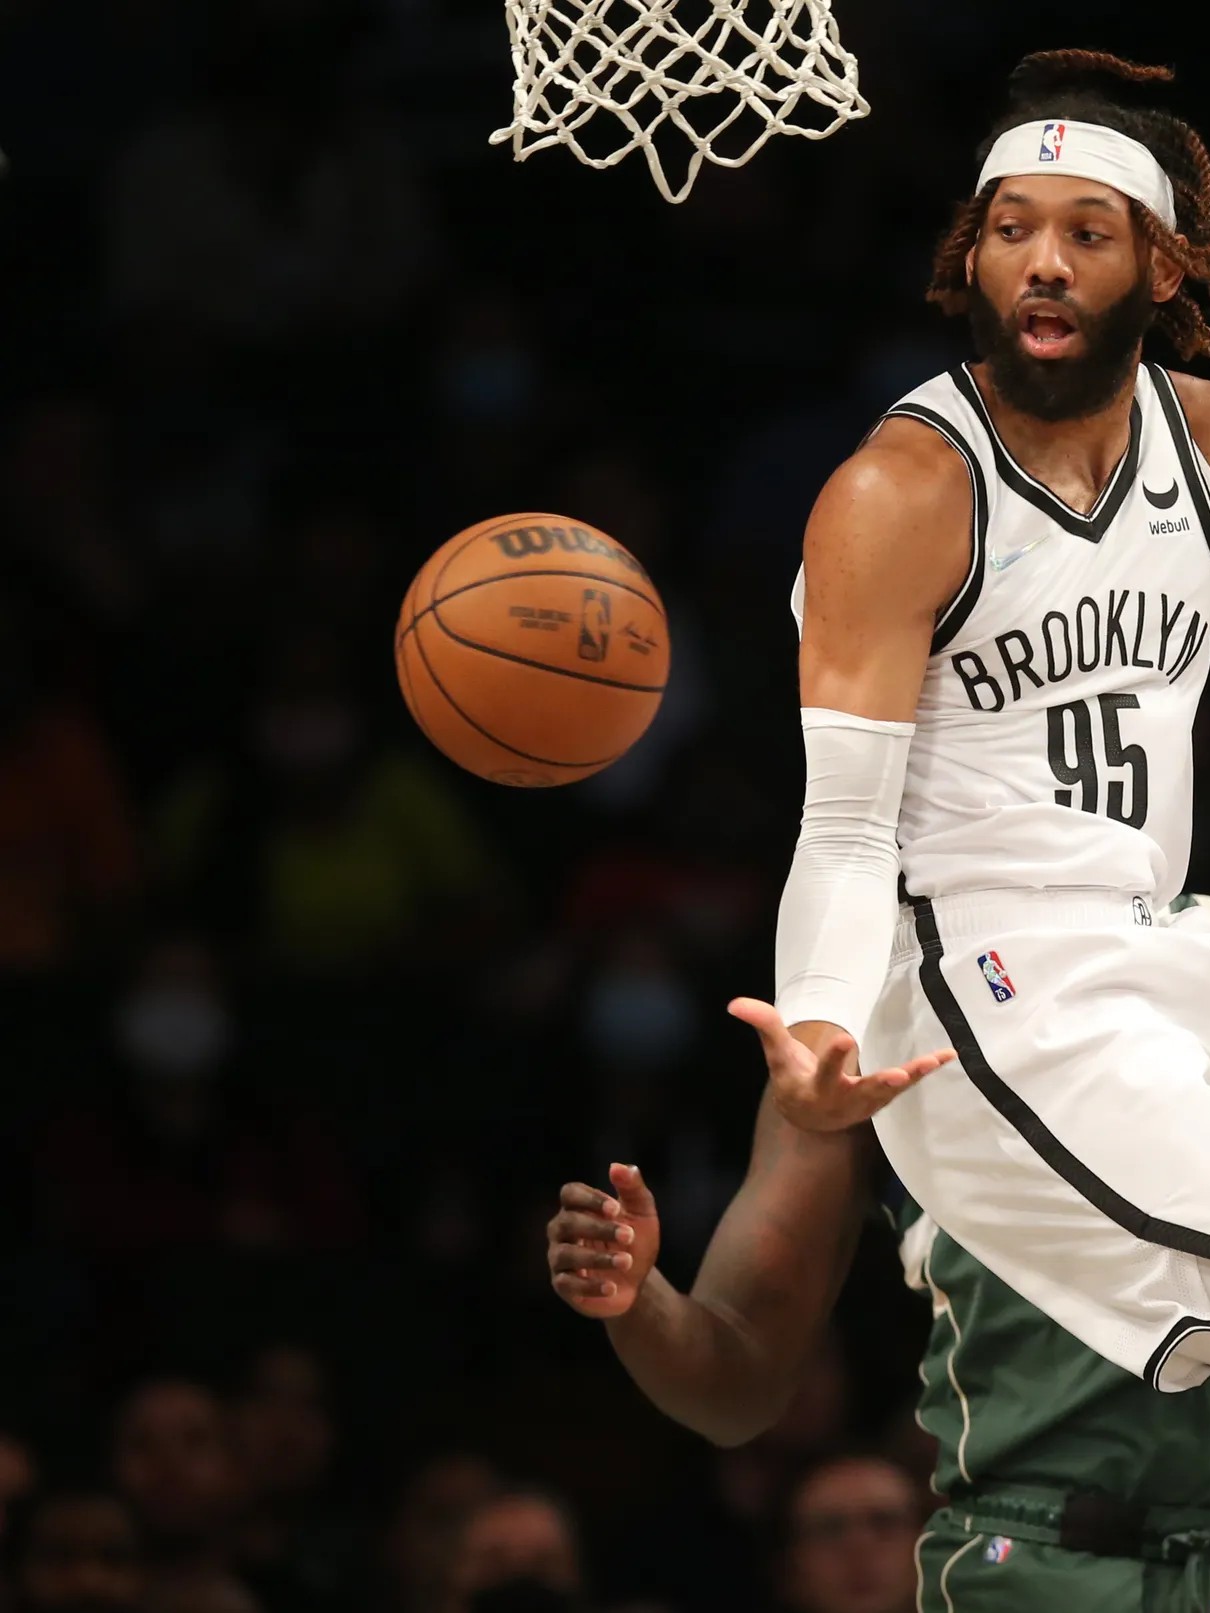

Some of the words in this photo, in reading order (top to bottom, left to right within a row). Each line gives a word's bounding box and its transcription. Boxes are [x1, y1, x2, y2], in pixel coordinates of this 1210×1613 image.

[1148, 516, 1190, 535] Webull
[951, 589, 1208, 712] BROOKLYN
[1046, 693, 1149, 830] 95
